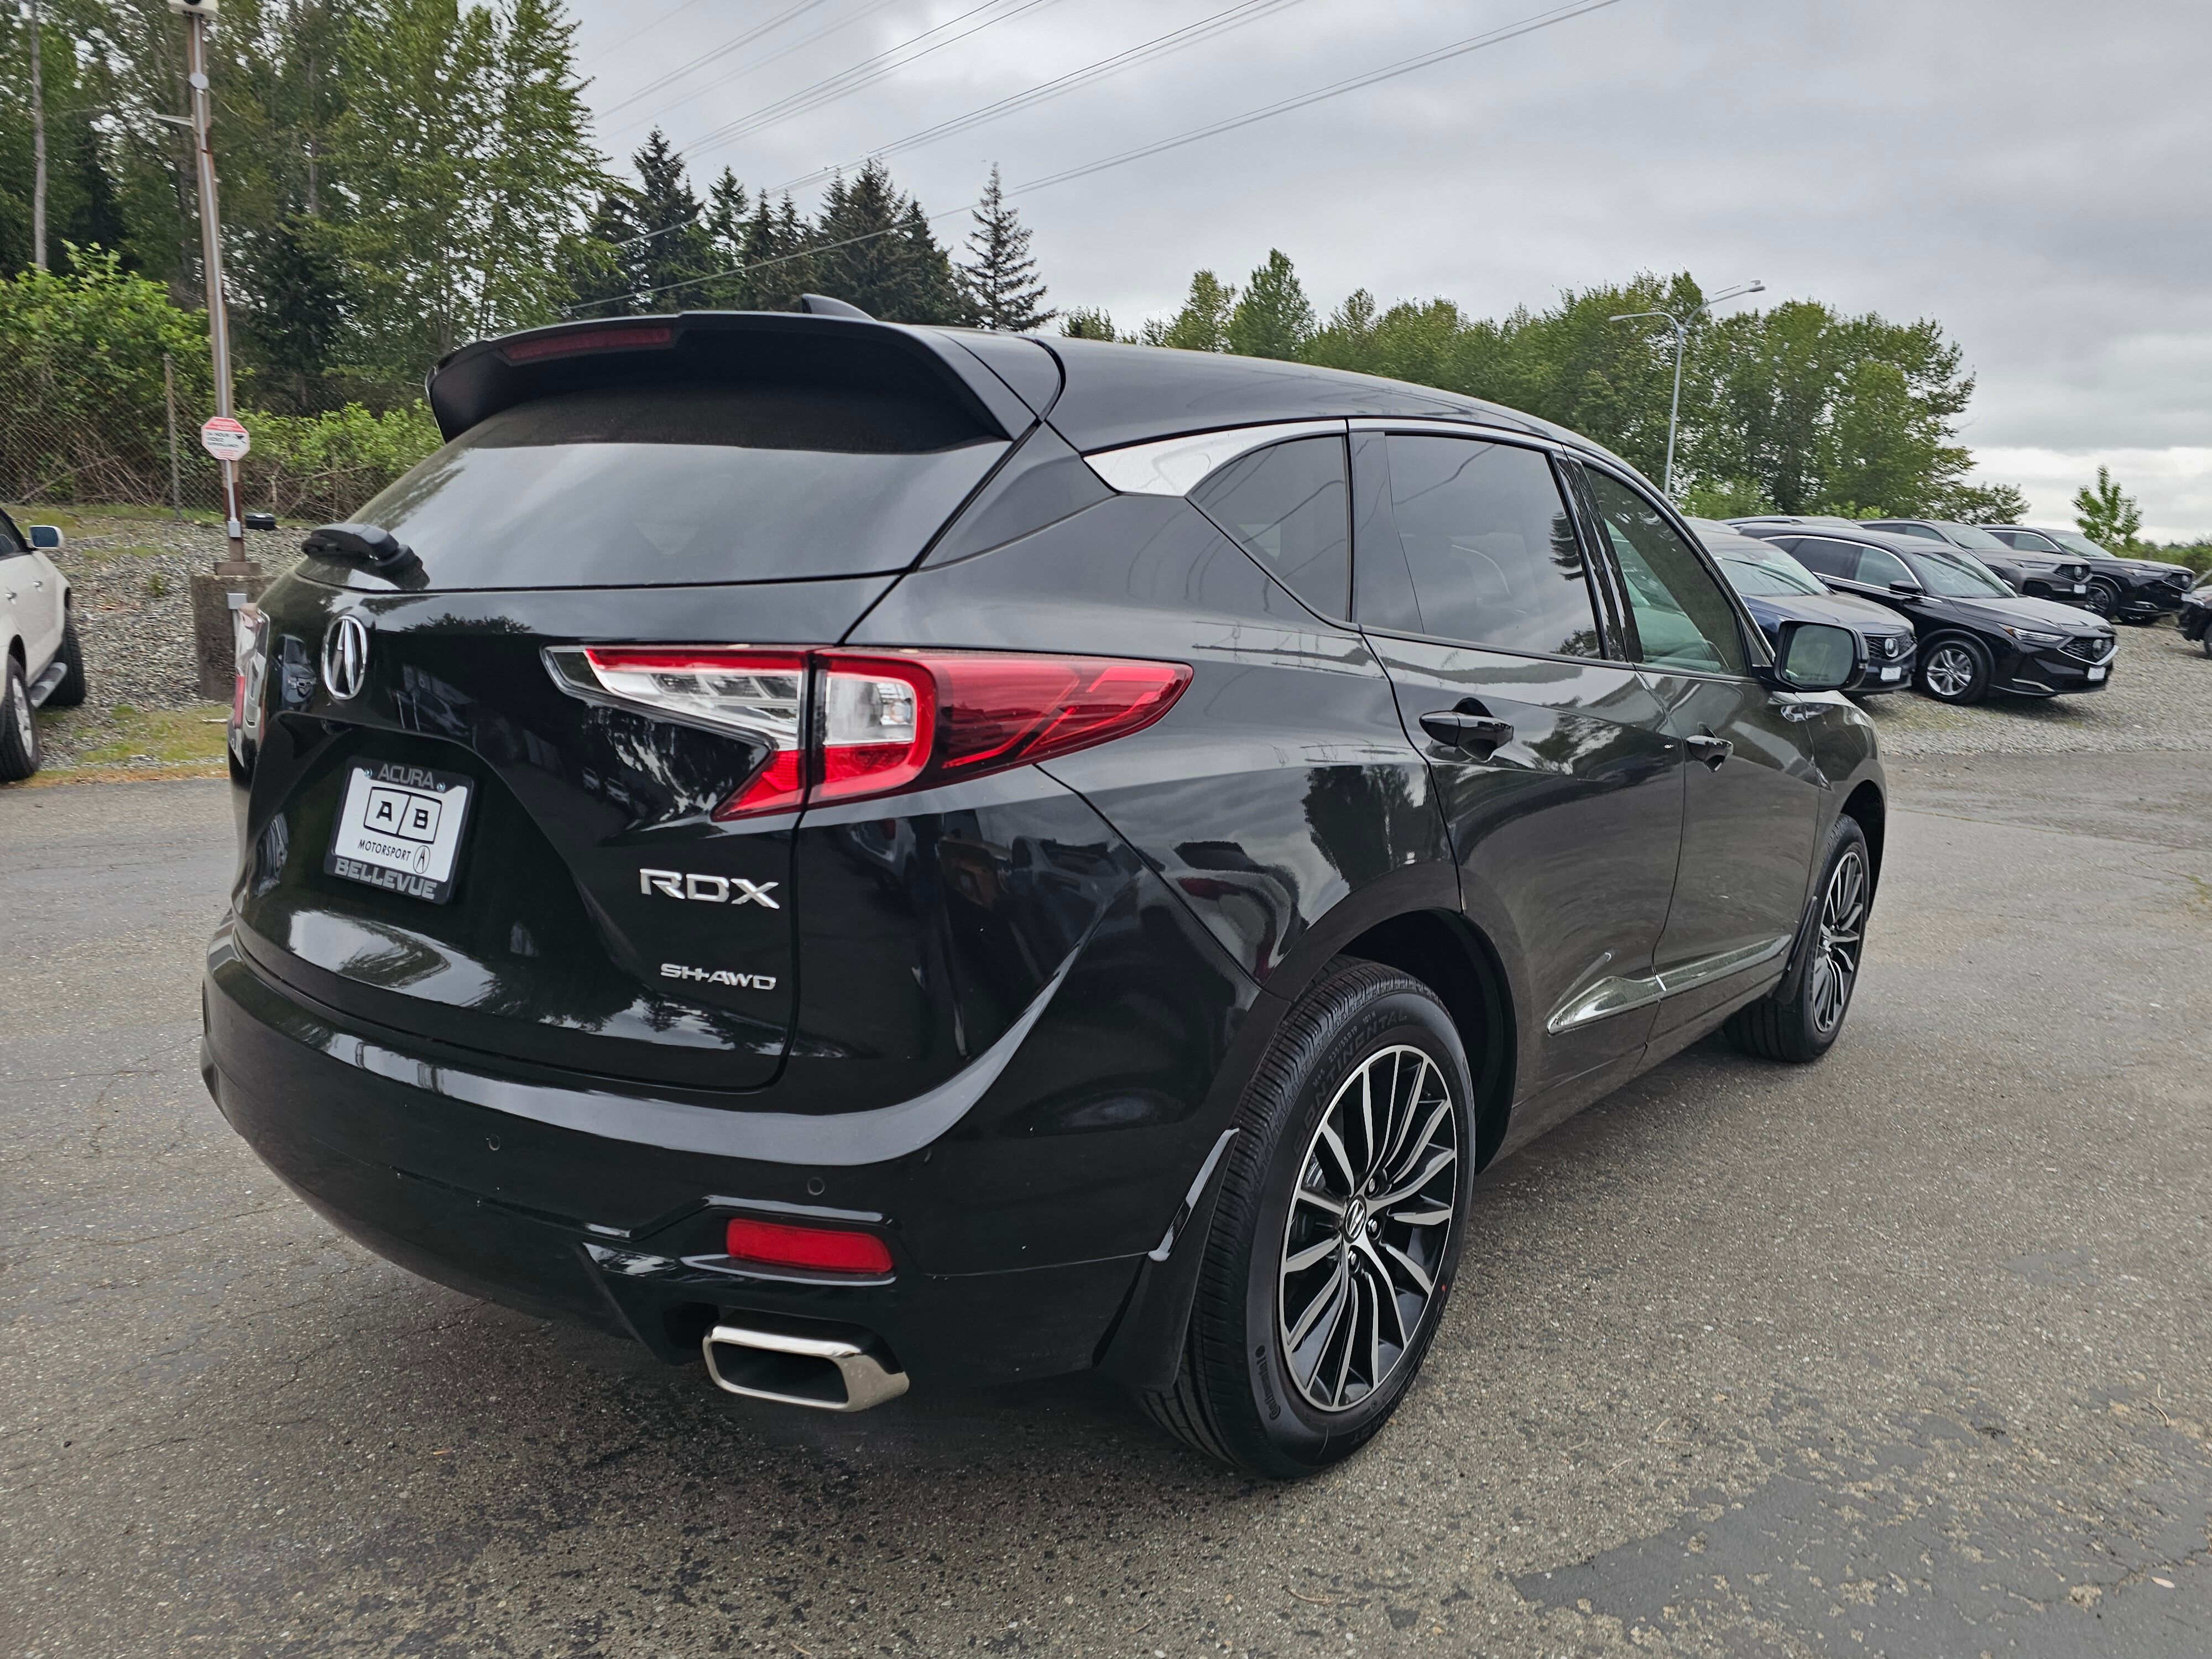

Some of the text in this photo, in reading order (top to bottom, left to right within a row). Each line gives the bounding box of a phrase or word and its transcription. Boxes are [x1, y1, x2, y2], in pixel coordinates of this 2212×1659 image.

[378, 764, 434, 789] ACURA
[358, 839, 411, 862] MOTORSPORT
[335, 858, 437, 900] BELLEVUE
[640, 868, 780, 909] RDX
[660, 963, 776, 990] SH-AWD
[1328, 1025, 1358, 1064] 235/55R19
